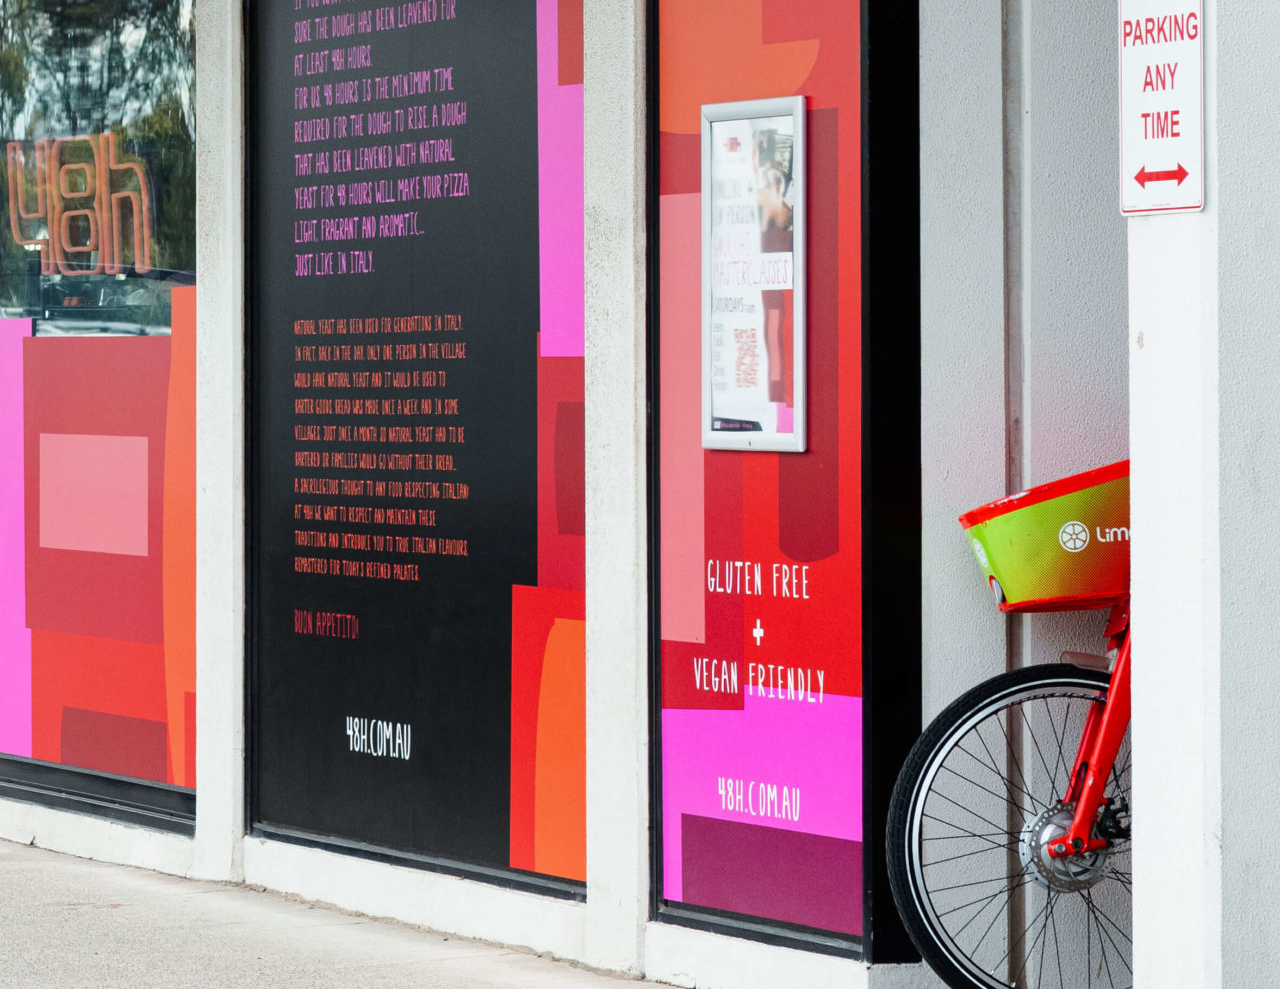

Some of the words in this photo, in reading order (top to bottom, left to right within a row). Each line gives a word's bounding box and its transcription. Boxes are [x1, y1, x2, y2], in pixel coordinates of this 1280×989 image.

[294, 19, 311, 44] SURE
[314, 16, 328, 41] THE
[331, 12, 354, 38] DOUGH
[358, 9, 371, 34] HAS
[375, 6, 394, 31] BEEN
[398, 0, 436, 28] LEAVENED
[1123, 12, 1198, 47] PARKING
[294, 54, 303, 76] AT
[306, 50, 328, 75] LEAST
[1143, 62, 1178, 92] ANY
[294, 86, 307, 110] FOR
[335, 79, 358, 105] HOURS
[362, 78, 370, 102] IS
[375, 75, 388, 100] THE
[392, 70, 430, 98] MINIMUM
[433, 67, 453, 93] TIME
[294, 117, 329, 143] REQUIRED
[333, 115, 346, 139] FOR
[350, 113, 363, 137] THE
[367, 110, 391, 135] DOUGH
[394, 109, 403, 132] TO
[432, 105, 438, 128] A
[441, 102, 466, 127] DOUGH
[1141, 110, 1180, 140] TIME
[294, 153, 312, 176] THAT
[315, 151, 328, 174] HAS
[333, 149, 350, 172] BEEN
[354, 145, 392, 170] LEAVENED
[395, 143, 416, 167] WITH
[419, 139, 455, 164] NATURAL
[294, 186, 317, 209] YEAST
[320, 184, 334, 207] FOR
[349, 181, 371, 205] HOURS
[375, 179, 395, 203] WILL
[397, 177, 419, 201] MAKE
[422, 175, 441, 200] YOUR
[443, 173, 469, 198] PIZZA
[320, 216, 358, 241] FRAGRANT
[361, 215, 376, 239] AND
[295, 254, 313, 276] JUST
[315, 253, 333, 275] LIKE
[337, 252, 346, 274] IN
[350, 251, 374, 274] ITALY.
[707, 559, 762, 595] GLUTEN
[773, 564, 810, 599] FREE
[294, 609, 313, 635] BUON
[693, 657, 738, 694] VEGAN
[749, 663, 824, 704] FRIENDLY
[346, 716, 411, 760] 48H.COM.AU
[718, 777, 800, 821] 48H.COM.AU
